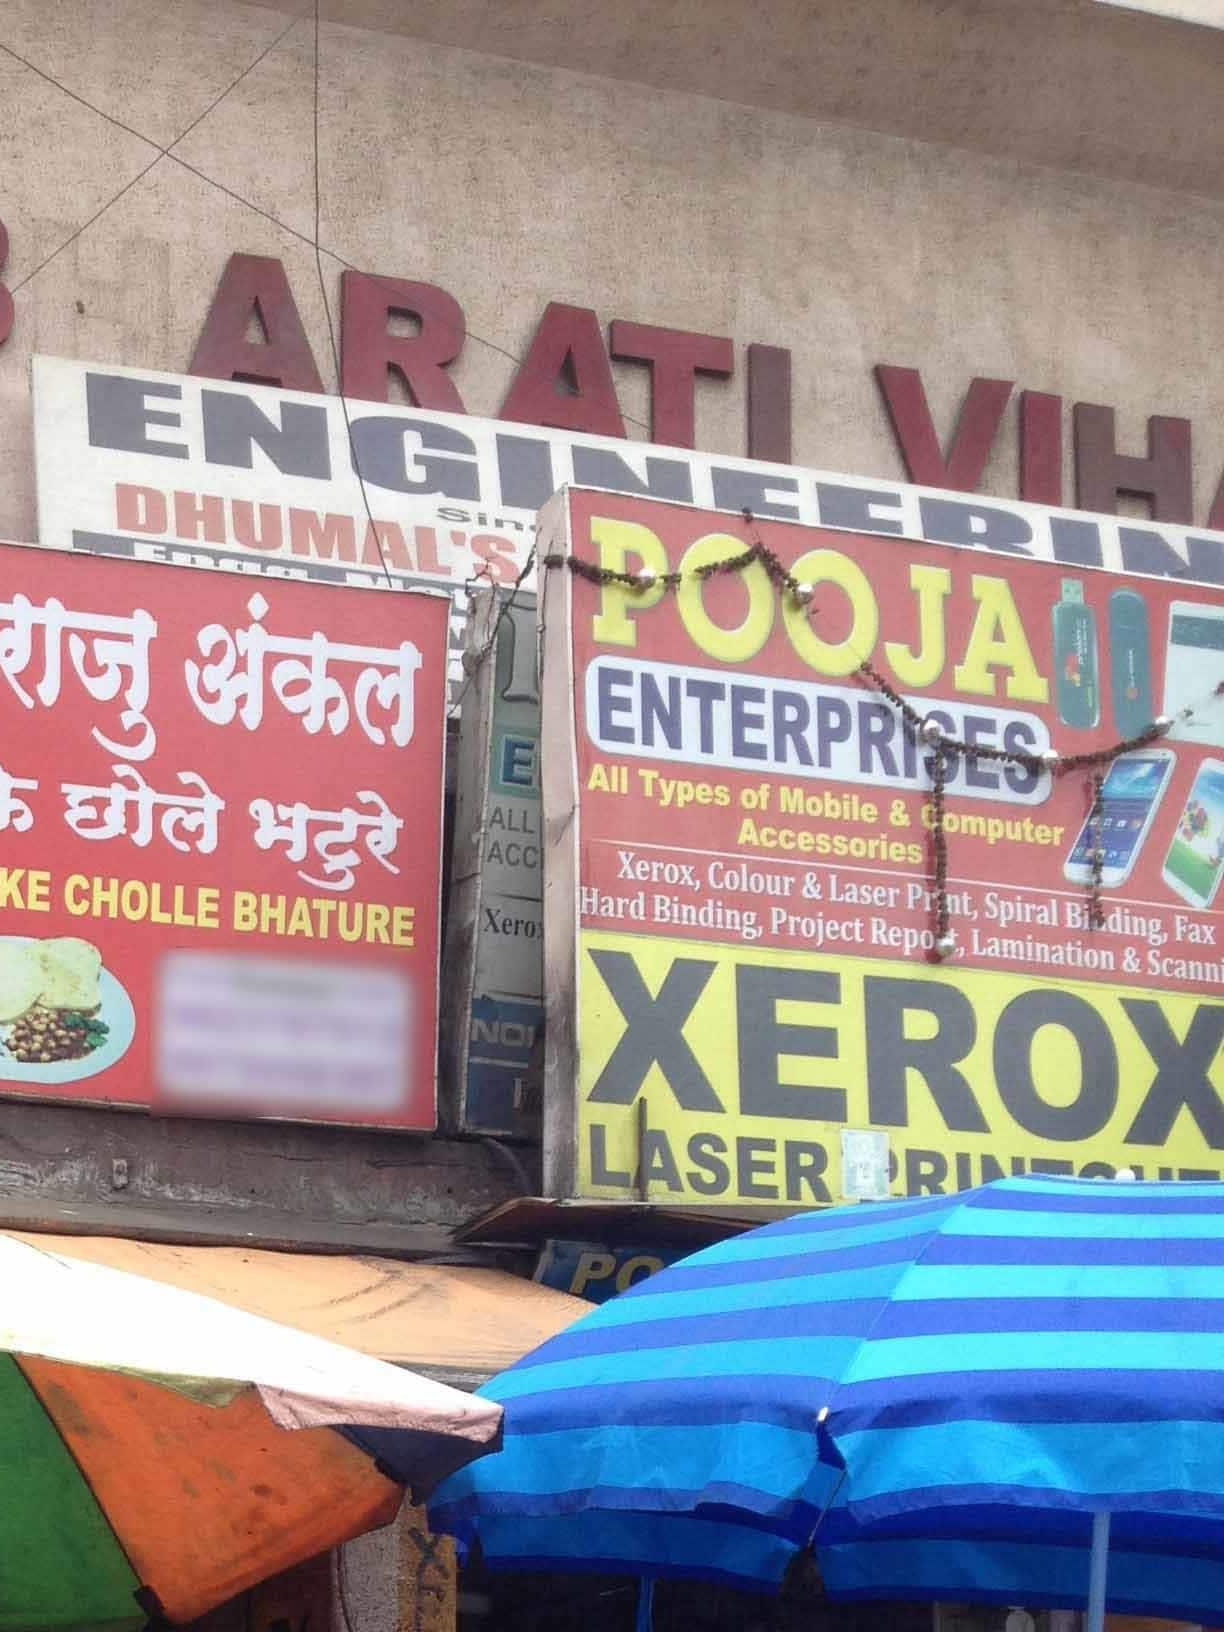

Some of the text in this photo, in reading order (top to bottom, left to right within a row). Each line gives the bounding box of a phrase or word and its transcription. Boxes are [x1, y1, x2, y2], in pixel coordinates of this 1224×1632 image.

[875, 363, 1224, 530] VIH
[115, 482, 522, 584] DHUMAL'S
[437, 506, 538, 536] Sin
[589, 516, 1051, 704] POOJA
[185, 591, 423, 748] अंकल
[596, 665, 1041, 796] ENTERPRISES
[61, 764, 225, 854] छोले
[489, 805, 534, 834] ALL
[587, 763, 629, 794] All
[638, 768, 731, 808] Types
[740, 782, 771, 812] of
[779, 785, 879, 824] Mobile
[888, 798, 912, 828] &
[737, 818, 923, 866] Accessories
[64, 873, 220, 929] CHOLLE
[233, 890, 415, 947] BHATURE
[579, 885, 646, 921] Hard
[652, 894, 764, 941] Binding,
[769, 906, 864, 947] Project
[870, 917, 965, 958] Repot,
[972, 928, 1115, 971] Lamination
[1121, 946, 1142, 974] &
[617, 850, 702, 891] Xerox,
[707, 861, 796, 897] Colour
[801, 871, 823, 900] &
[828, 874, 901, 909] Laser
[907, 882, 978, 920] Prnt,
[984, 892, 1066, 930] Spiral
[1175, 914, 1217, 945] Fax
[587, 947, 1224, 1152] XEROX
[588, 1122, 831, 1204] LASER
